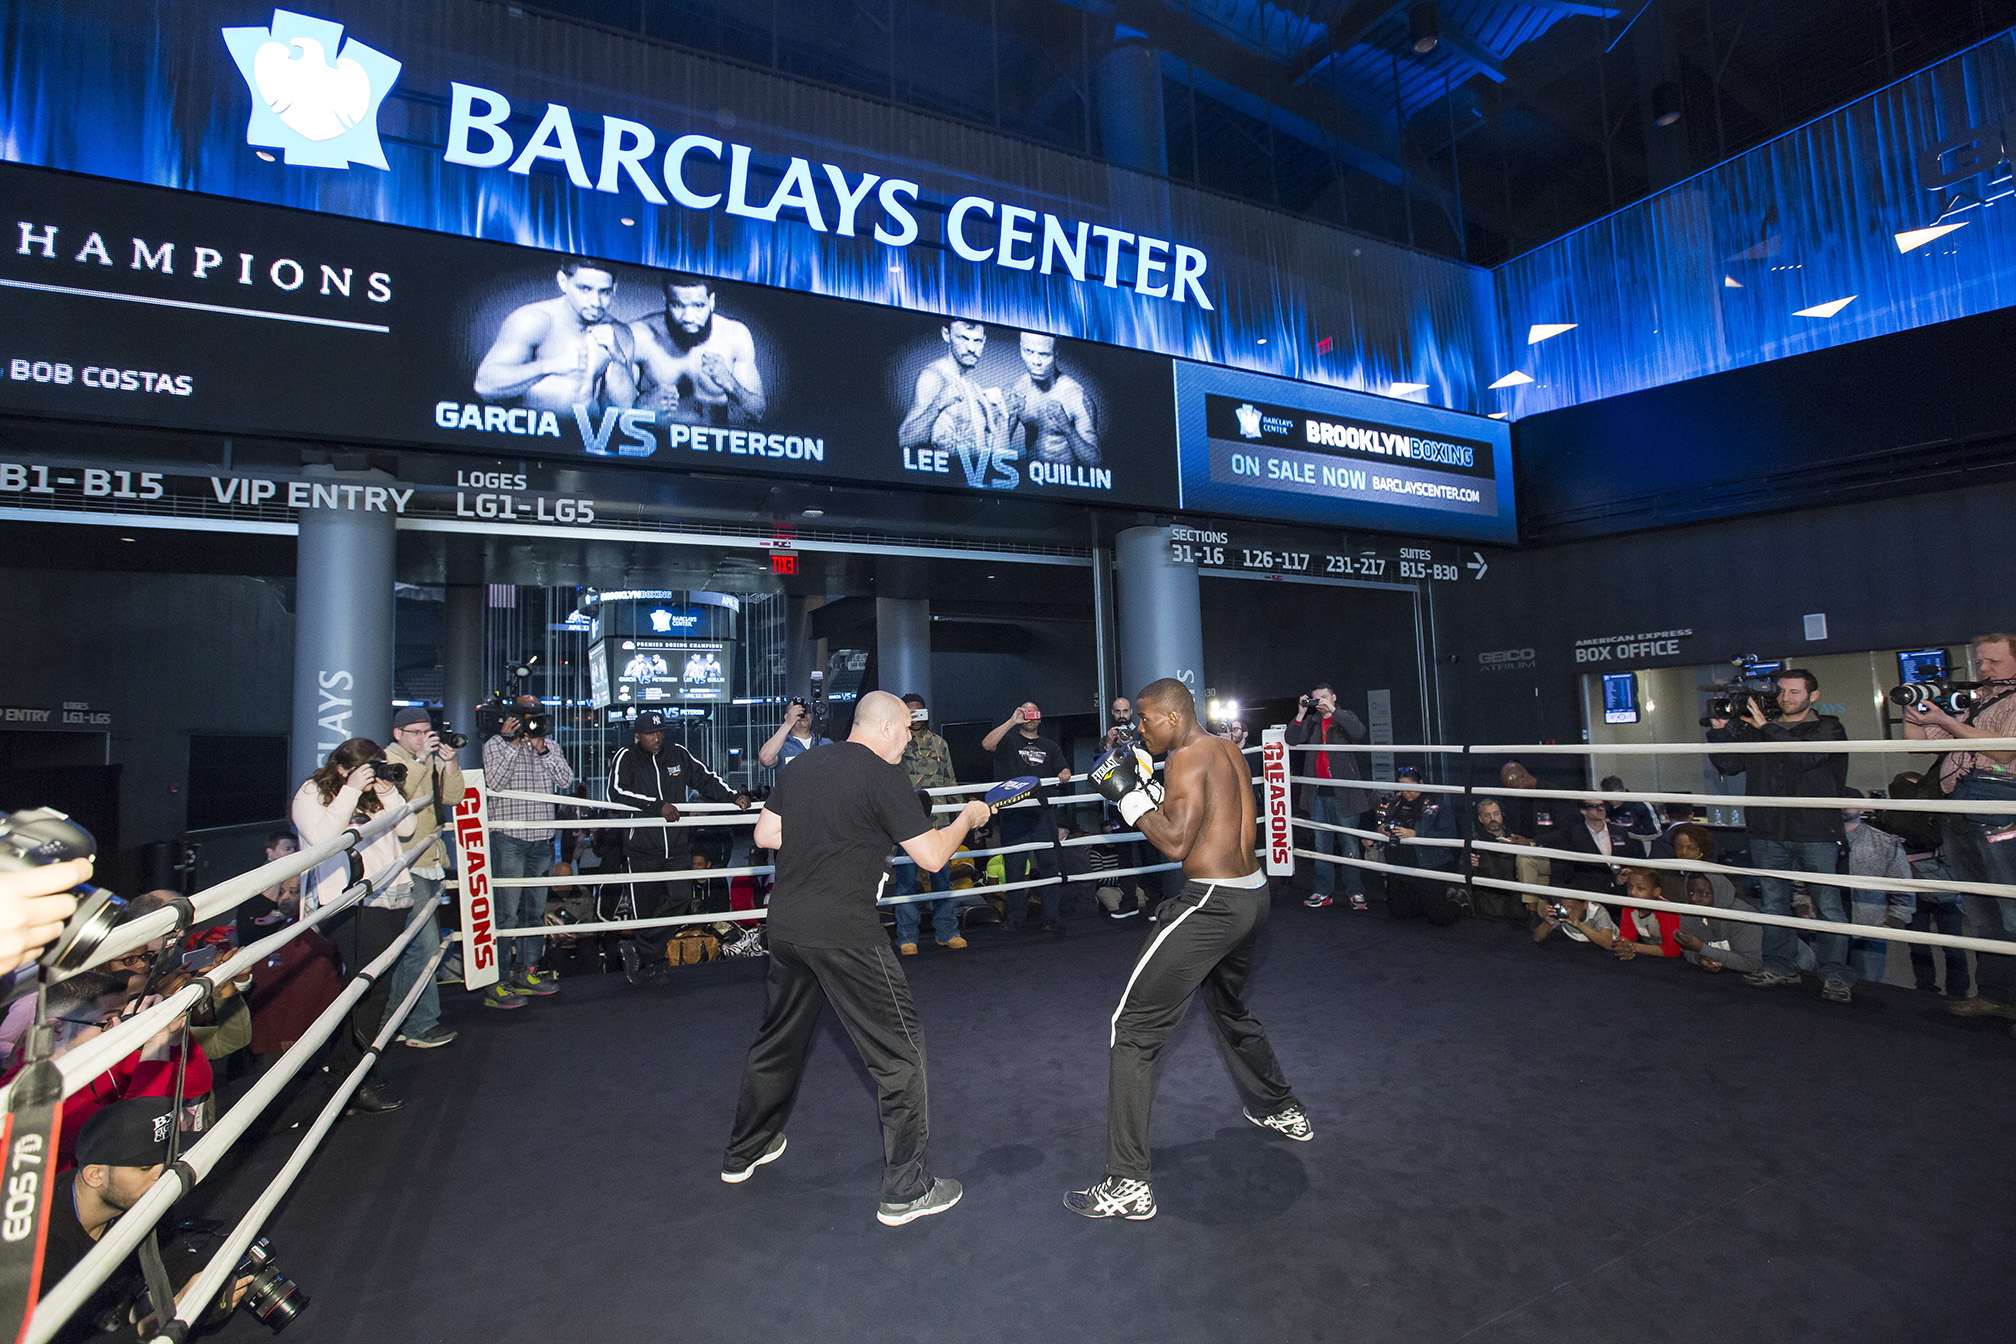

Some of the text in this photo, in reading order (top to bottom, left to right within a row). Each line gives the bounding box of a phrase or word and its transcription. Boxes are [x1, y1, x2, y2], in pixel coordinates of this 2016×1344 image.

[444, 82, 1214, 311] BARCLAYS CENTER
[16, 221, 392, 303] HAMPIONS
[10, 358, 193, 396] BOB COSTAS
[435, 401, 825, 462] GARCIA VS PETERSON
[1263, 416, 1294, 428] BARCLAYS
[1263, 424, 1289, 435] CENTER
[0, 463, 163, 500] B1-B15
[457, 470, 527, 490] LOGES
[903, 446, 1113, 490] LEE VS QUILLIN
[1231, 453, 1480, 503] ON SALE NOW BARCLAYSCENTER.COM
[210, 477, 415, 513] VIP ENTRY
[456, 492, 595, 524] LG1-LG5
[1172, 528, 1229, 544] SECTIONS
[1172, 545, 1386, 576] 31-16 126-117 231-217
[1400, 548, 1431, 561] SUITES
[1400, 562, 1459, 581] B15-B30
[1575, 628, 1693, 647] AMERICAN EXPRESS
[1575, 639, 1681, 663] BOX OFFICE
[1478, 648, 1536, 664] GEICO
[1480, 660, 1536, 672] ATRIUM
[5, 708, 51, 722] ENTRY
[662, 707, 680, 719] VS
[1264, 741, 1292, 865] GLEASON'S
[455, 787, 497, 971] GLEASON'S
[2, 1133, 43, 1242] EOS 7D
